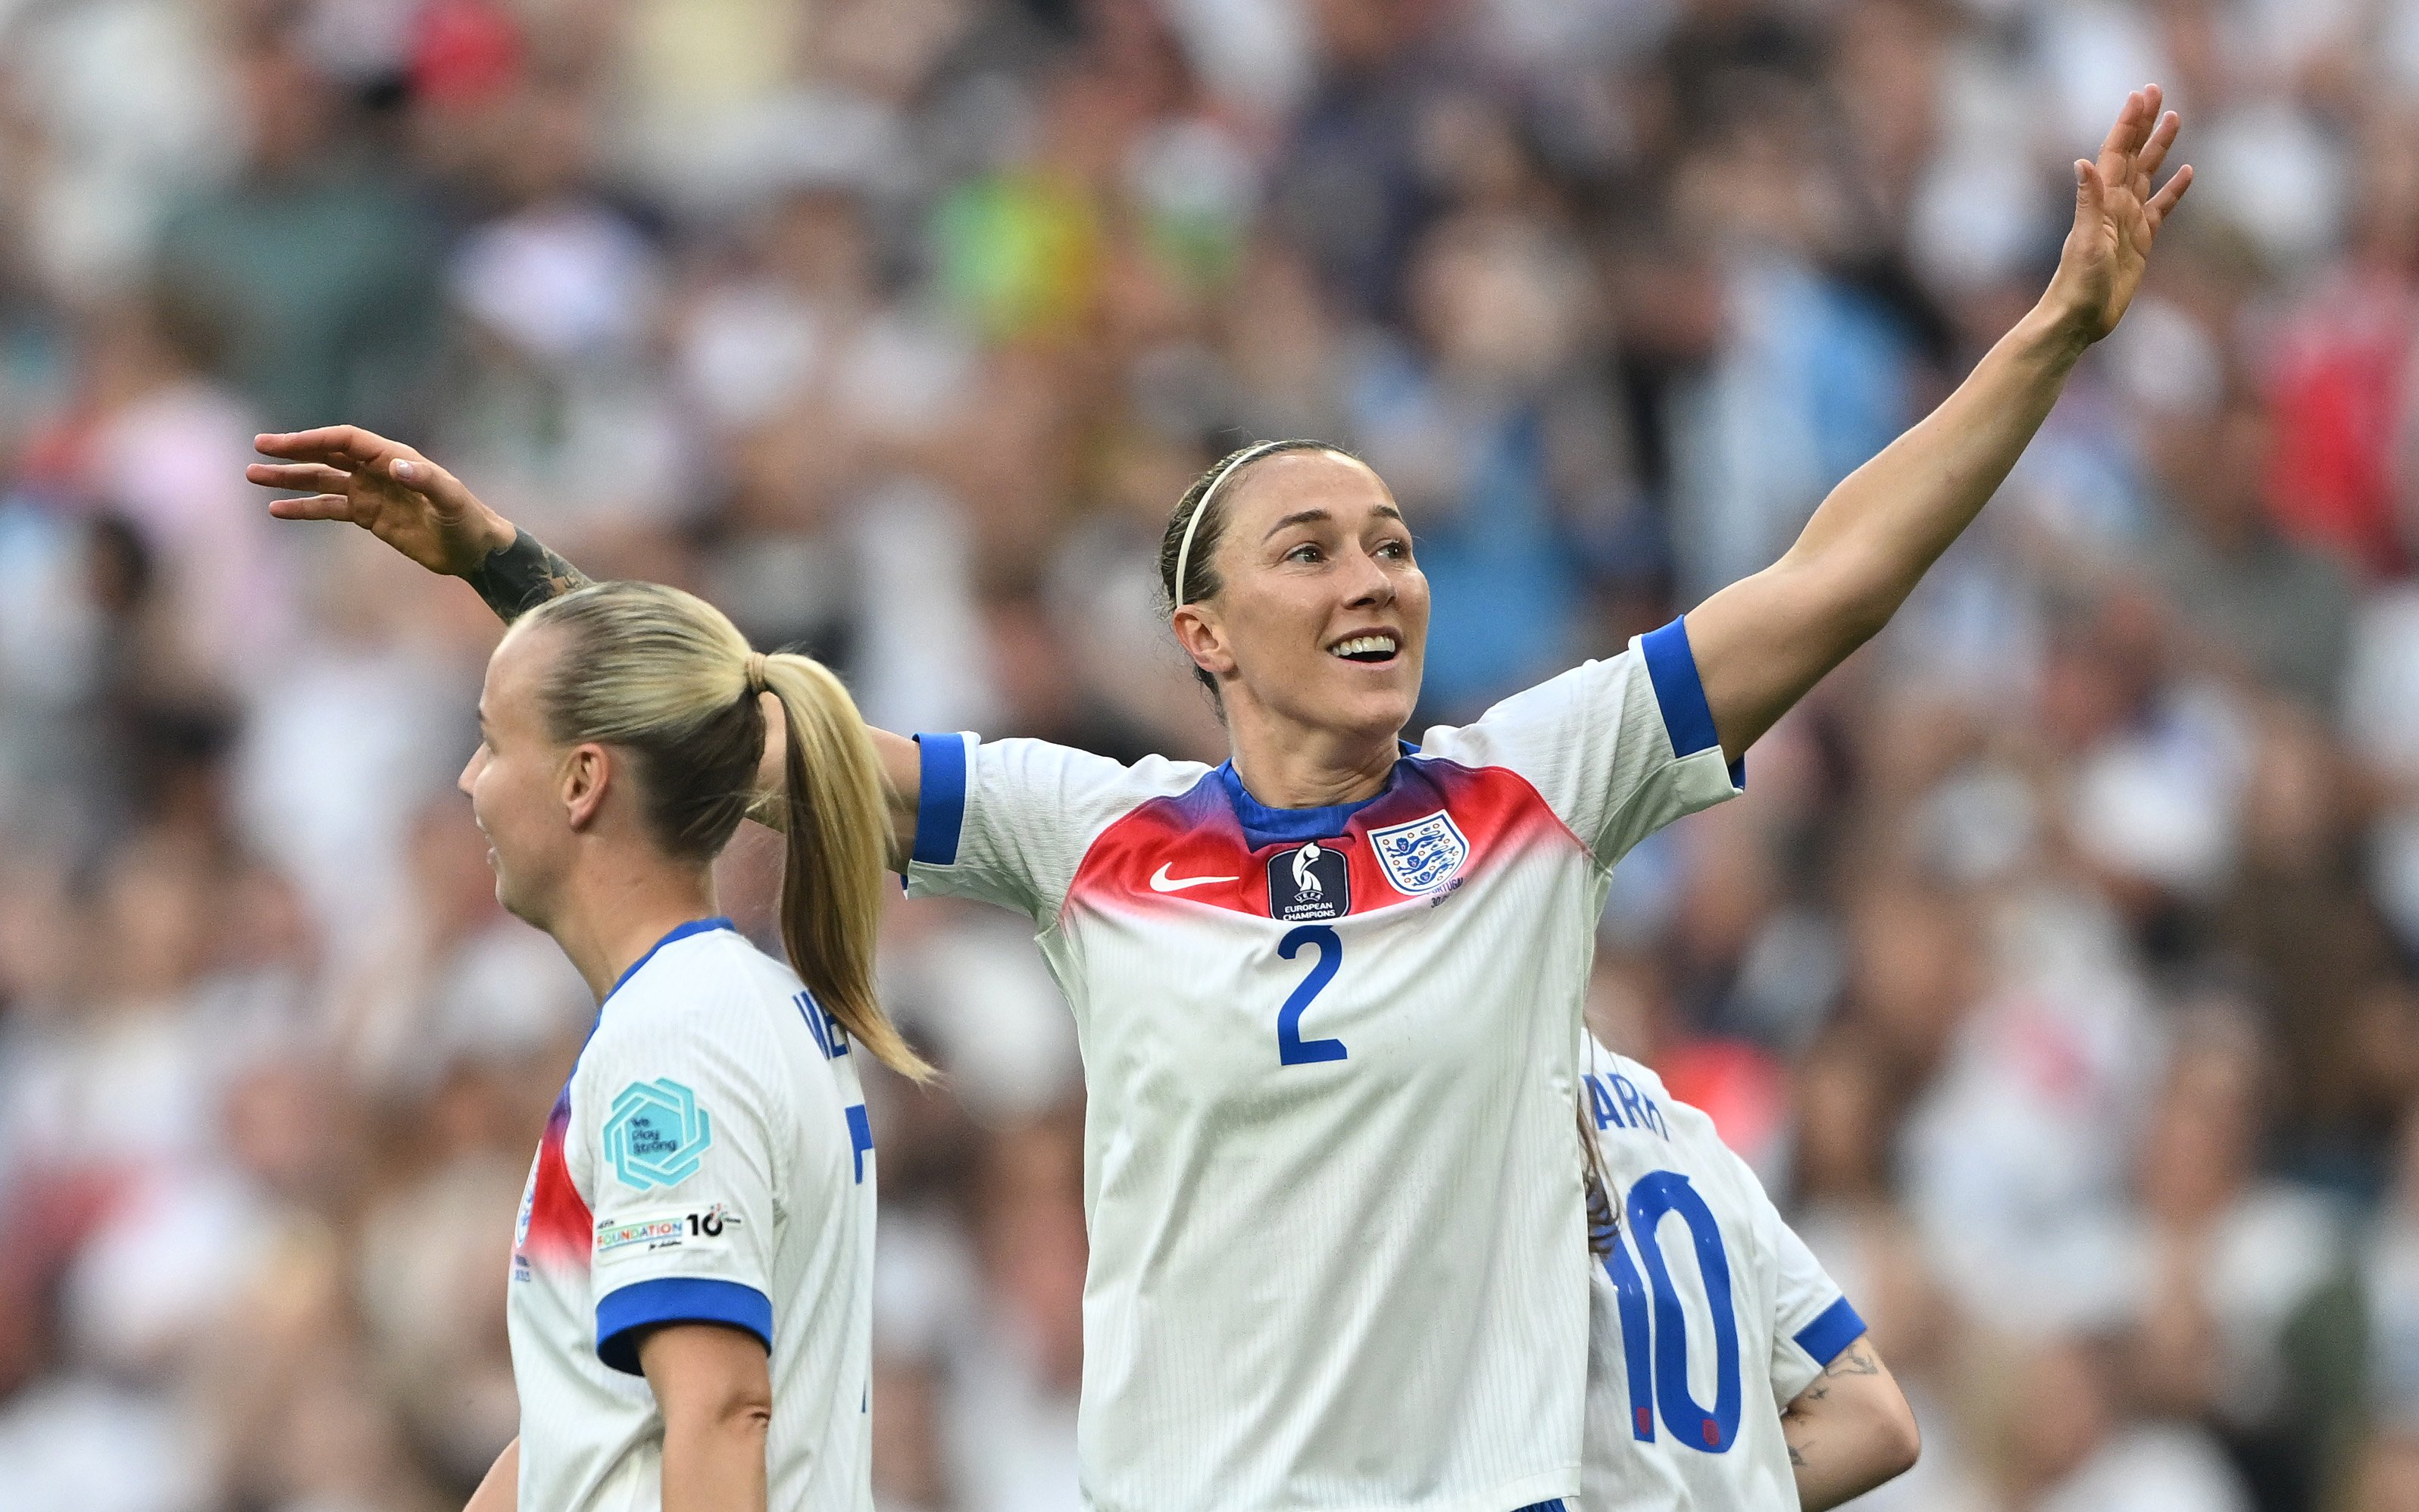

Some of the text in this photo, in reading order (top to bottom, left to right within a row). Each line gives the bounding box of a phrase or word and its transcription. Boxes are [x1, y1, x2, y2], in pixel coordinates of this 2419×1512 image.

[1295, 892, 1321, 901] UEFA
[1284, 901, 1333, 914] EUROPEAN
[1283, 909, 1336, 921] CHAMPIONS
[1277, 924, 1348, 1066] 2
[1588, 1170, 1741, 1453] 10
